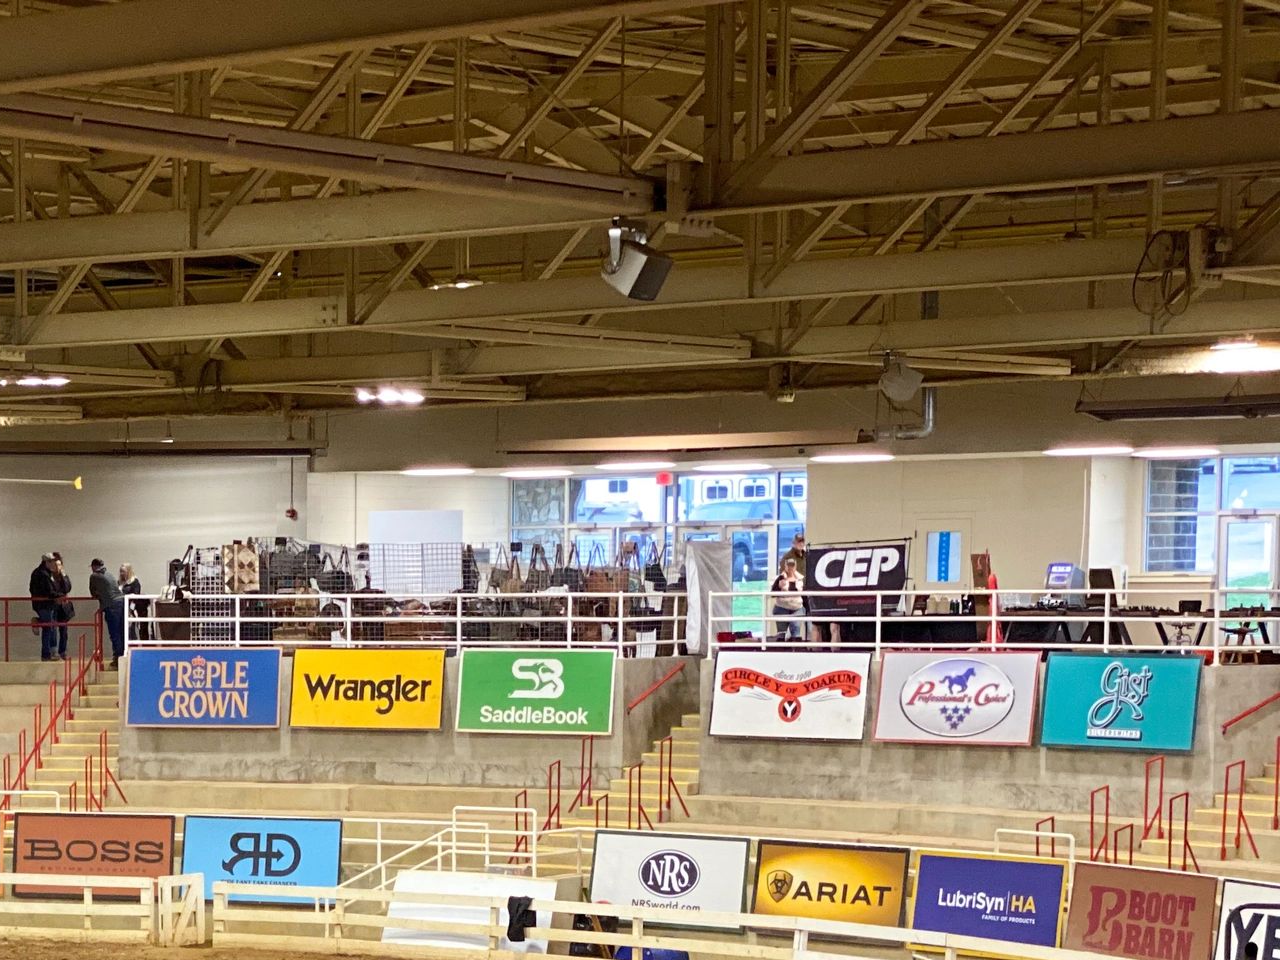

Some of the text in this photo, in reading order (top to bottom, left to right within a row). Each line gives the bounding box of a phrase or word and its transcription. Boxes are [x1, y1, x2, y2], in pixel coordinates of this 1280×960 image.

[814, 547, 900, 588] CEP
[303, 673, 432, 715] Wrangler
[724, 669, 771, 688] CIRCLE
[773, 682, 783, 692] Y
[803, 673, 857, 693] YOAKUM
[1087, 661, 1153, 728] Gist
[158, 690, 249, 719] CROWN
[479, 705, 589, 725] SaddleBook
[23, 838, 164, 863] BOSS
[647, 854, 690, 892] NRS
[631, 898, 701, 911] NRSworldcom
[792, 880, 892, 907] ARIAT
[938, 888, 1036, 914] LubriSyn HA
[981, 914, 999, 922] FAMILY
[1008, 917, 1036, 925] PRODUCTS
[1127, 889, 1196, 927] BOOT
